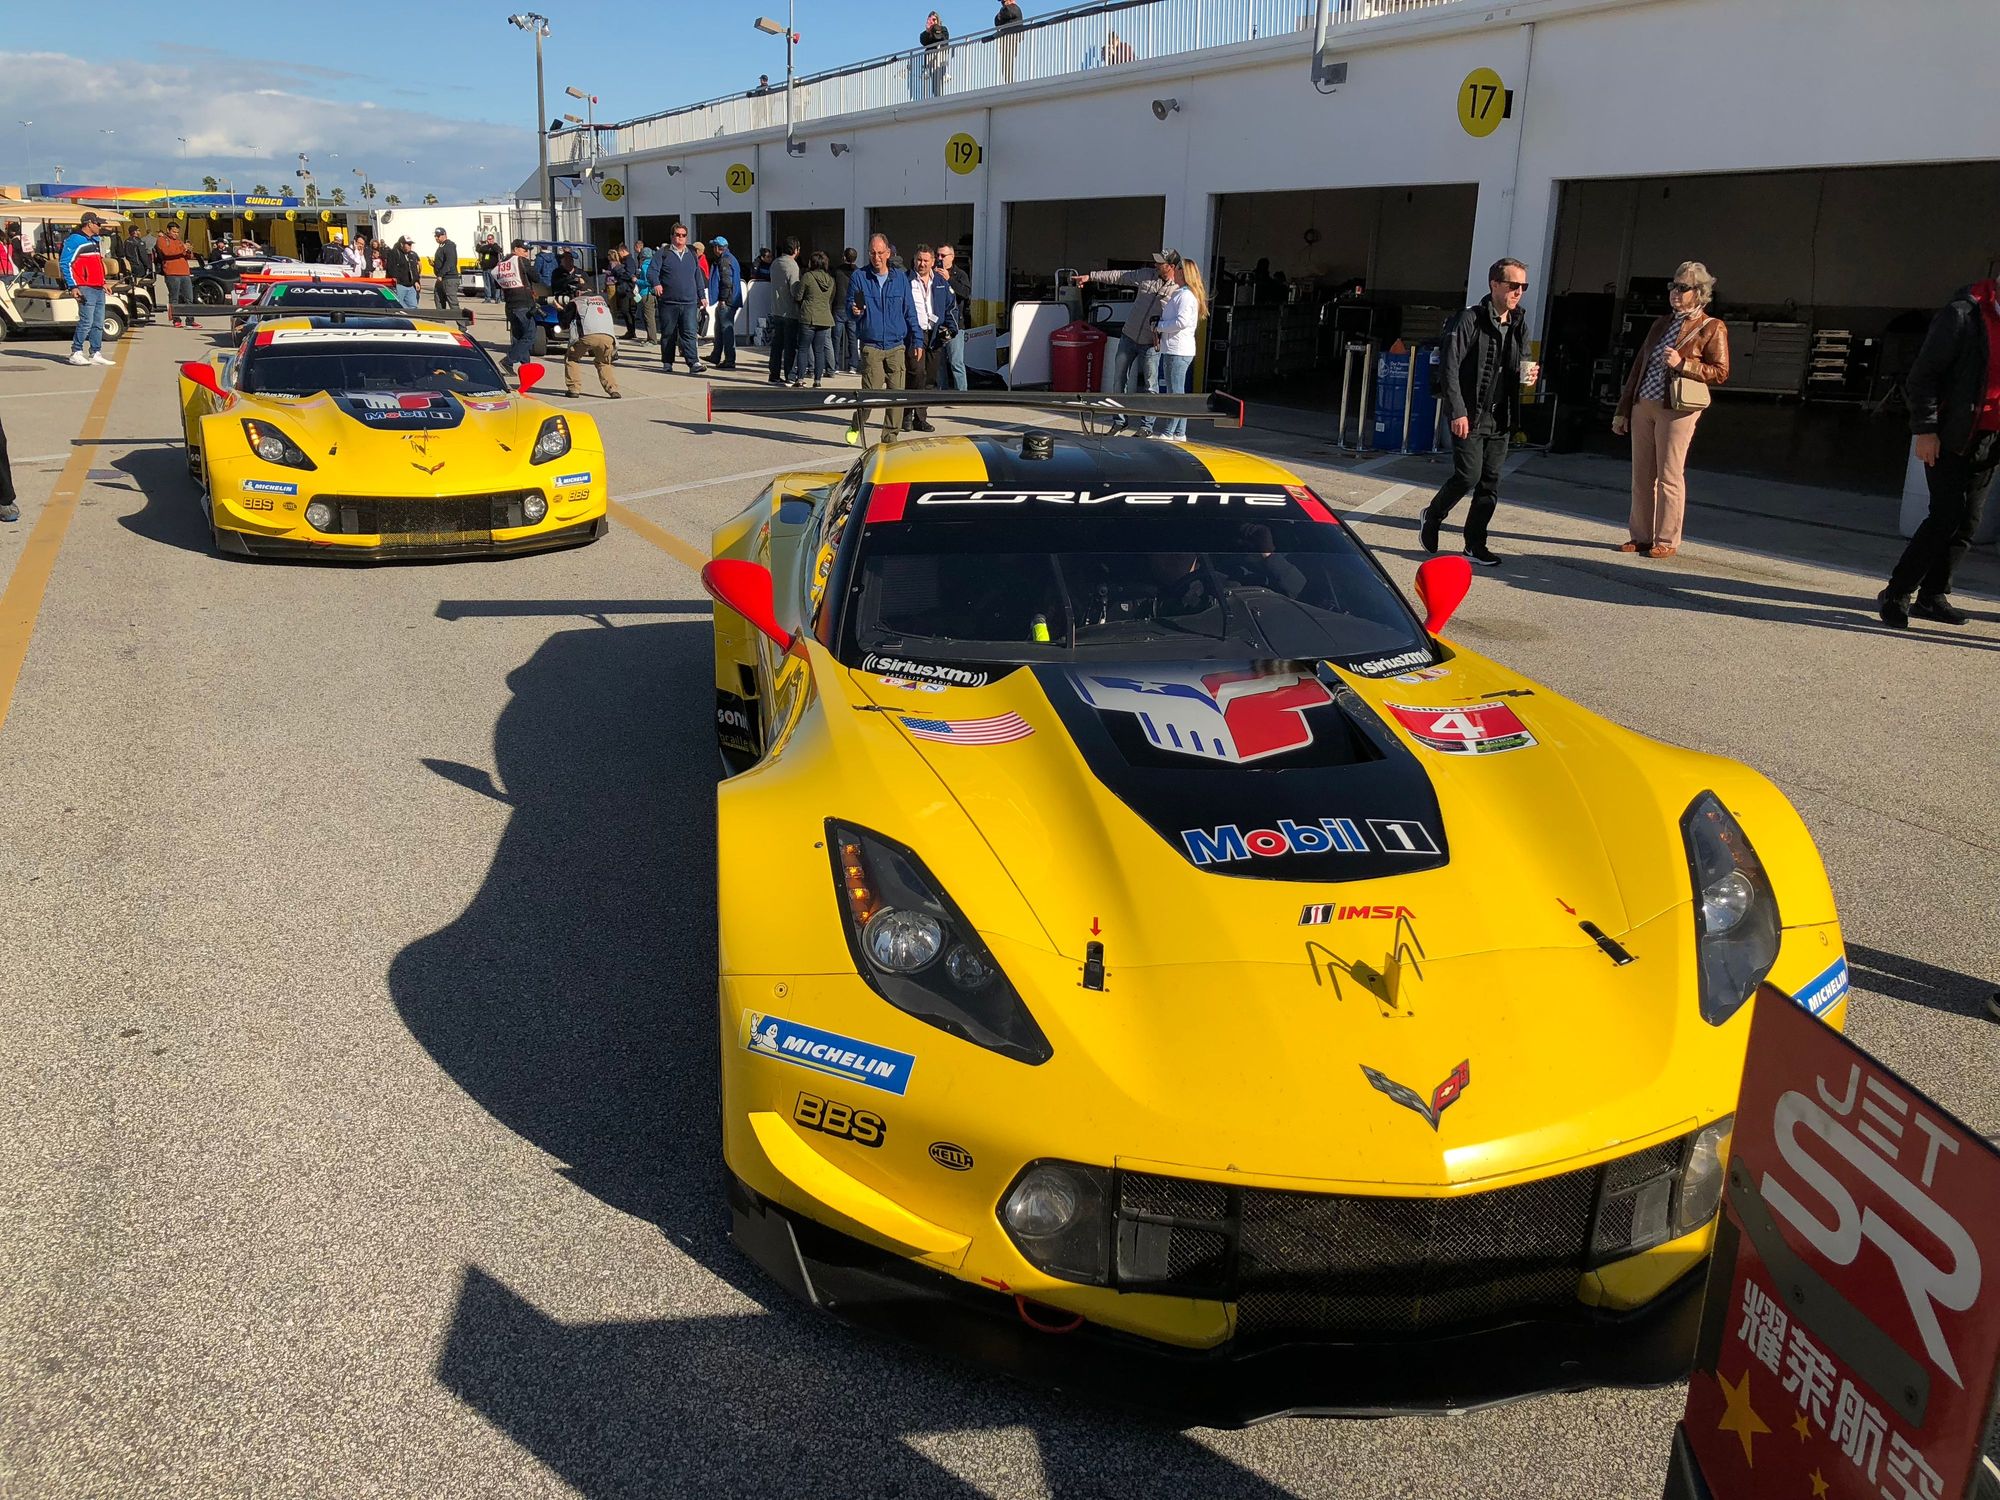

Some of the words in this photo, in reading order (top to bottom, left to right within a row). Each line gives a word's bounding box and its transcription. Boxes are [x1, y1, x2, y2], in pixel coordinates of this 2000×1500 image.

[1468, 84, 1498, 119] 17
[953, 142, 972, 164] 19
[731, 171, 746, 186] 21
[605, 184, 621, 196] 23
[245, 196, 283, 206] SUNOCO
[305, 288, 378, 296] ACURA
[278, 331, 450, 339] CORVETTE
[364, 410, 427, 421] Mobil
[254, 483, 293, 492] MICHELIN
[568, 488, 590, 502] BBS
[243, 497, 274, 511] BBS
[916, 490, 1287, 507] CORVETTE
[885, 672, 925, 682] SATELLITE
[927, 679, 952, 687] RADIO
[1430, 713, 1486, 739] 4
[1181, 818, 1370, 865] Mobil
[1337, 905, 1417, 921] IMSA
[1807, 969, 1847, 1012] MICHELIN
[782, 1035, 896, 1078] MICHELIN
[793, 1091, 887, 1148] BBS
[1816, 1064, 1960, 1188] JET
[931, 1146, 974, 1170] HELLA
[1760, 1090, 1982, 1390] SR
